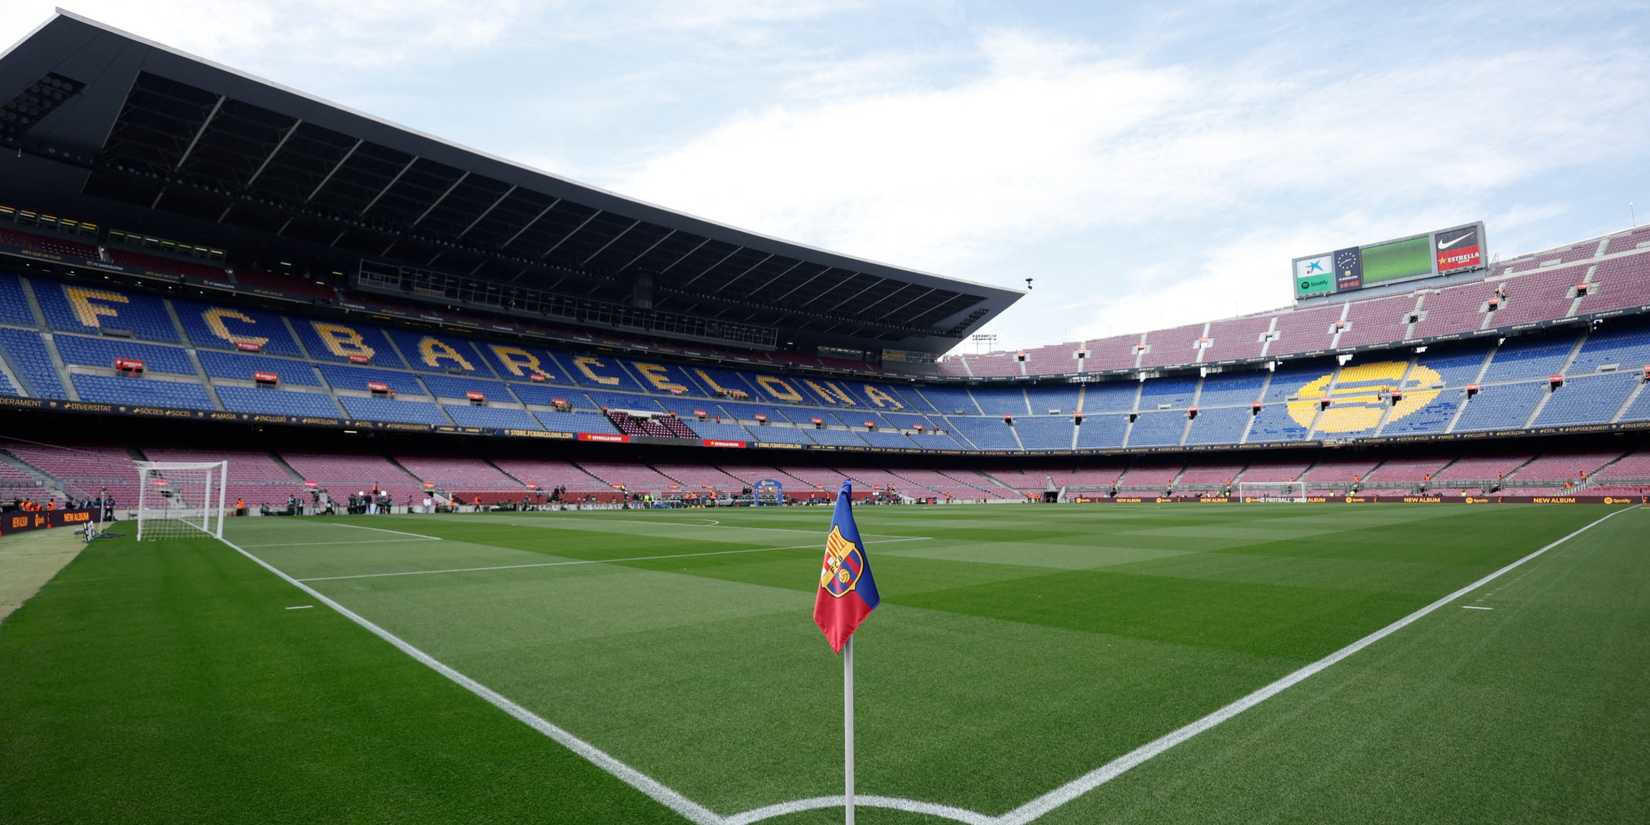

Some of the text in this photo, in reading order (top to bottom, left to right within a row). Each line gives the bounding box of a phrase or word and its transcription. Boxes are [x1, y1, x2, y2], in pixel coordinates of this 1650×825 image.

[1447, 251, 1480, 263] ESTRELLA
[65, 286, 903, 410] FC BARCELONA
